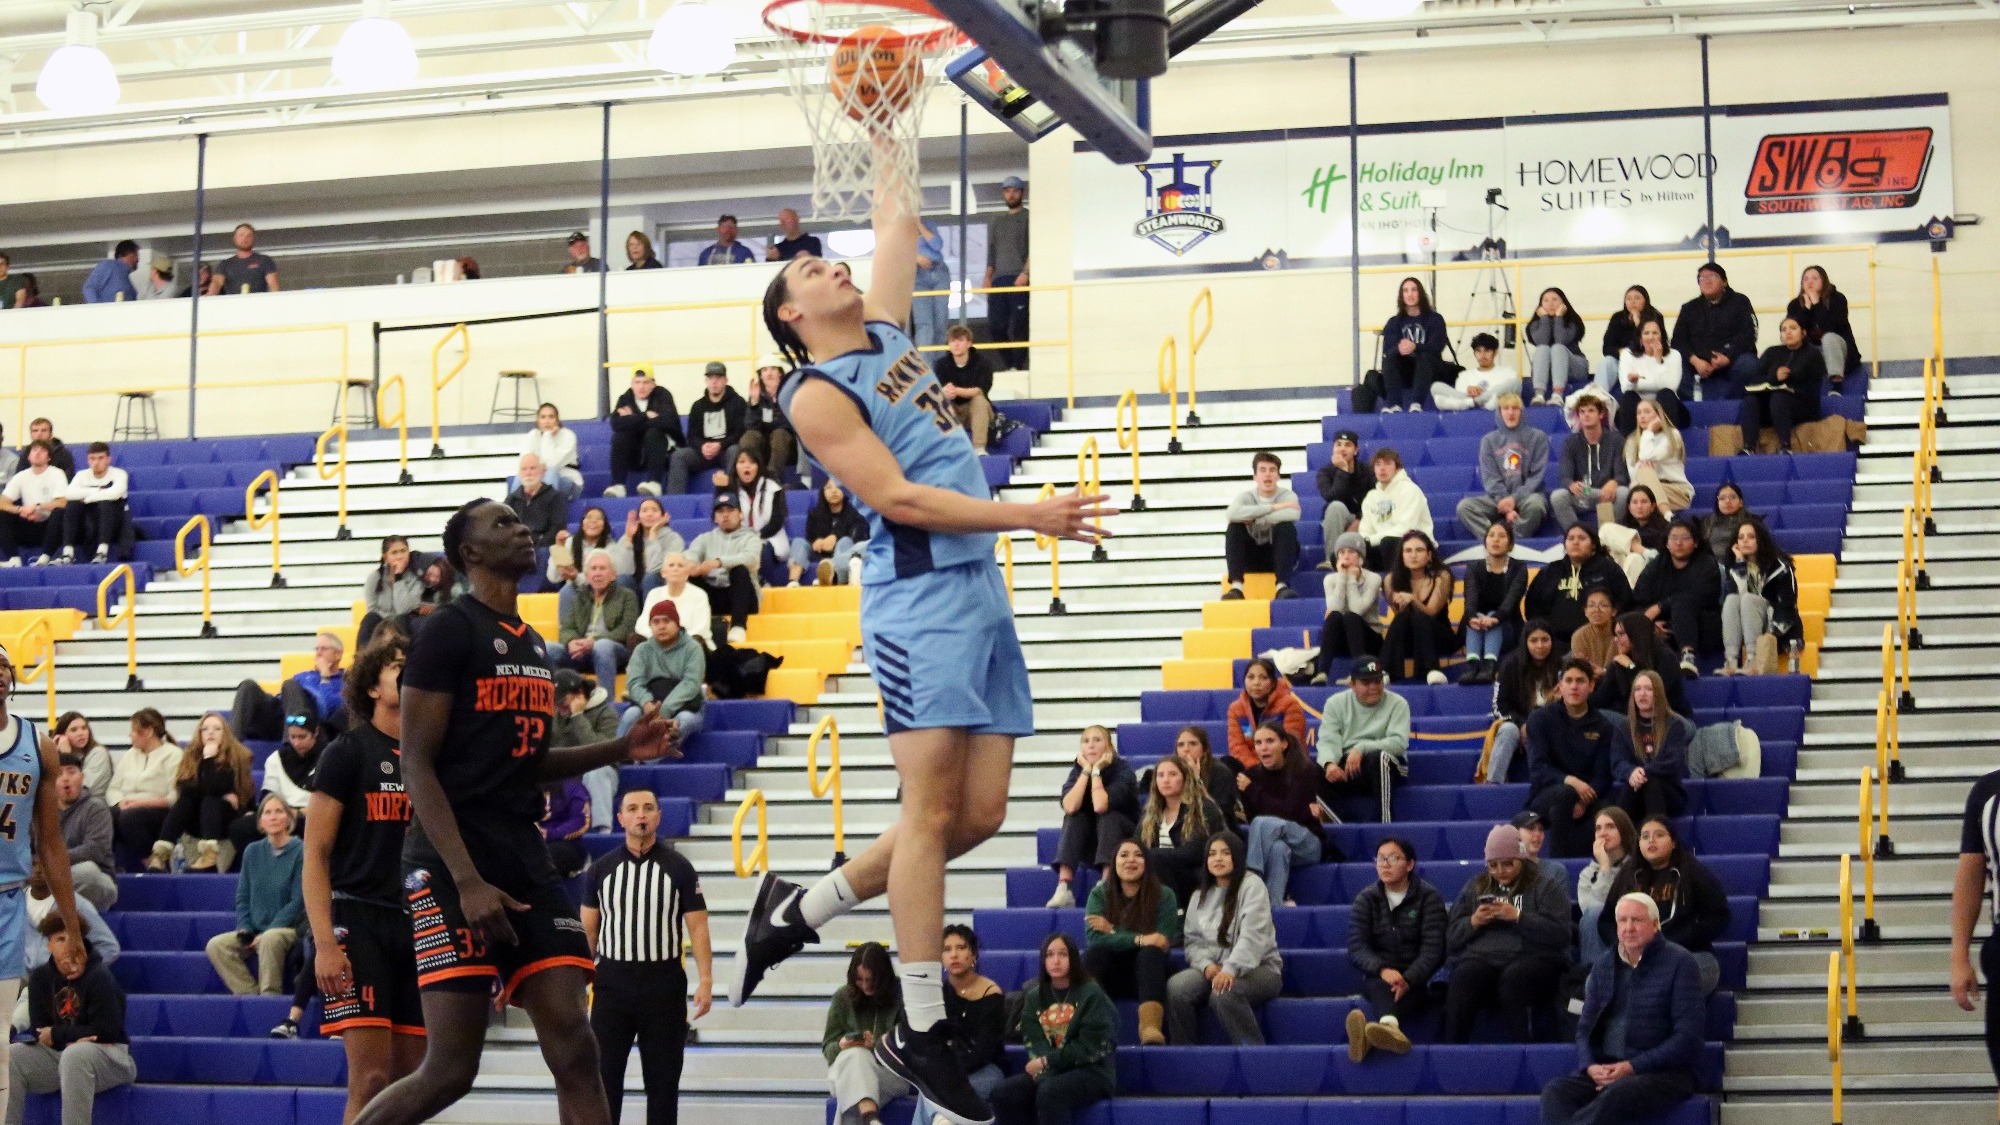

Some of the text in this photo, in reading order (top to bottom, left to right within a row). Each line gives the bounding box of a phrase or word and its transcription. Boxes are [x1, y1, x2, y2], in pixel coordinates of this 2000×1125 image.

[1359, 158, 1484, 185] Holiday Inn
[1516, 153, 1717, 187] HOMEWOOD
[1360, 192, 1373, 212] &
[1541, 189, 1632, 212] SUITES
[1657, 190, 1695, 202] Hilton
[1138, 213, 1221, 235] STEAMWORKS
[495, 664, 520, 676] NEW
[380, 782, 405, 792] NEW
[361, 984, 375, 1012] 4
